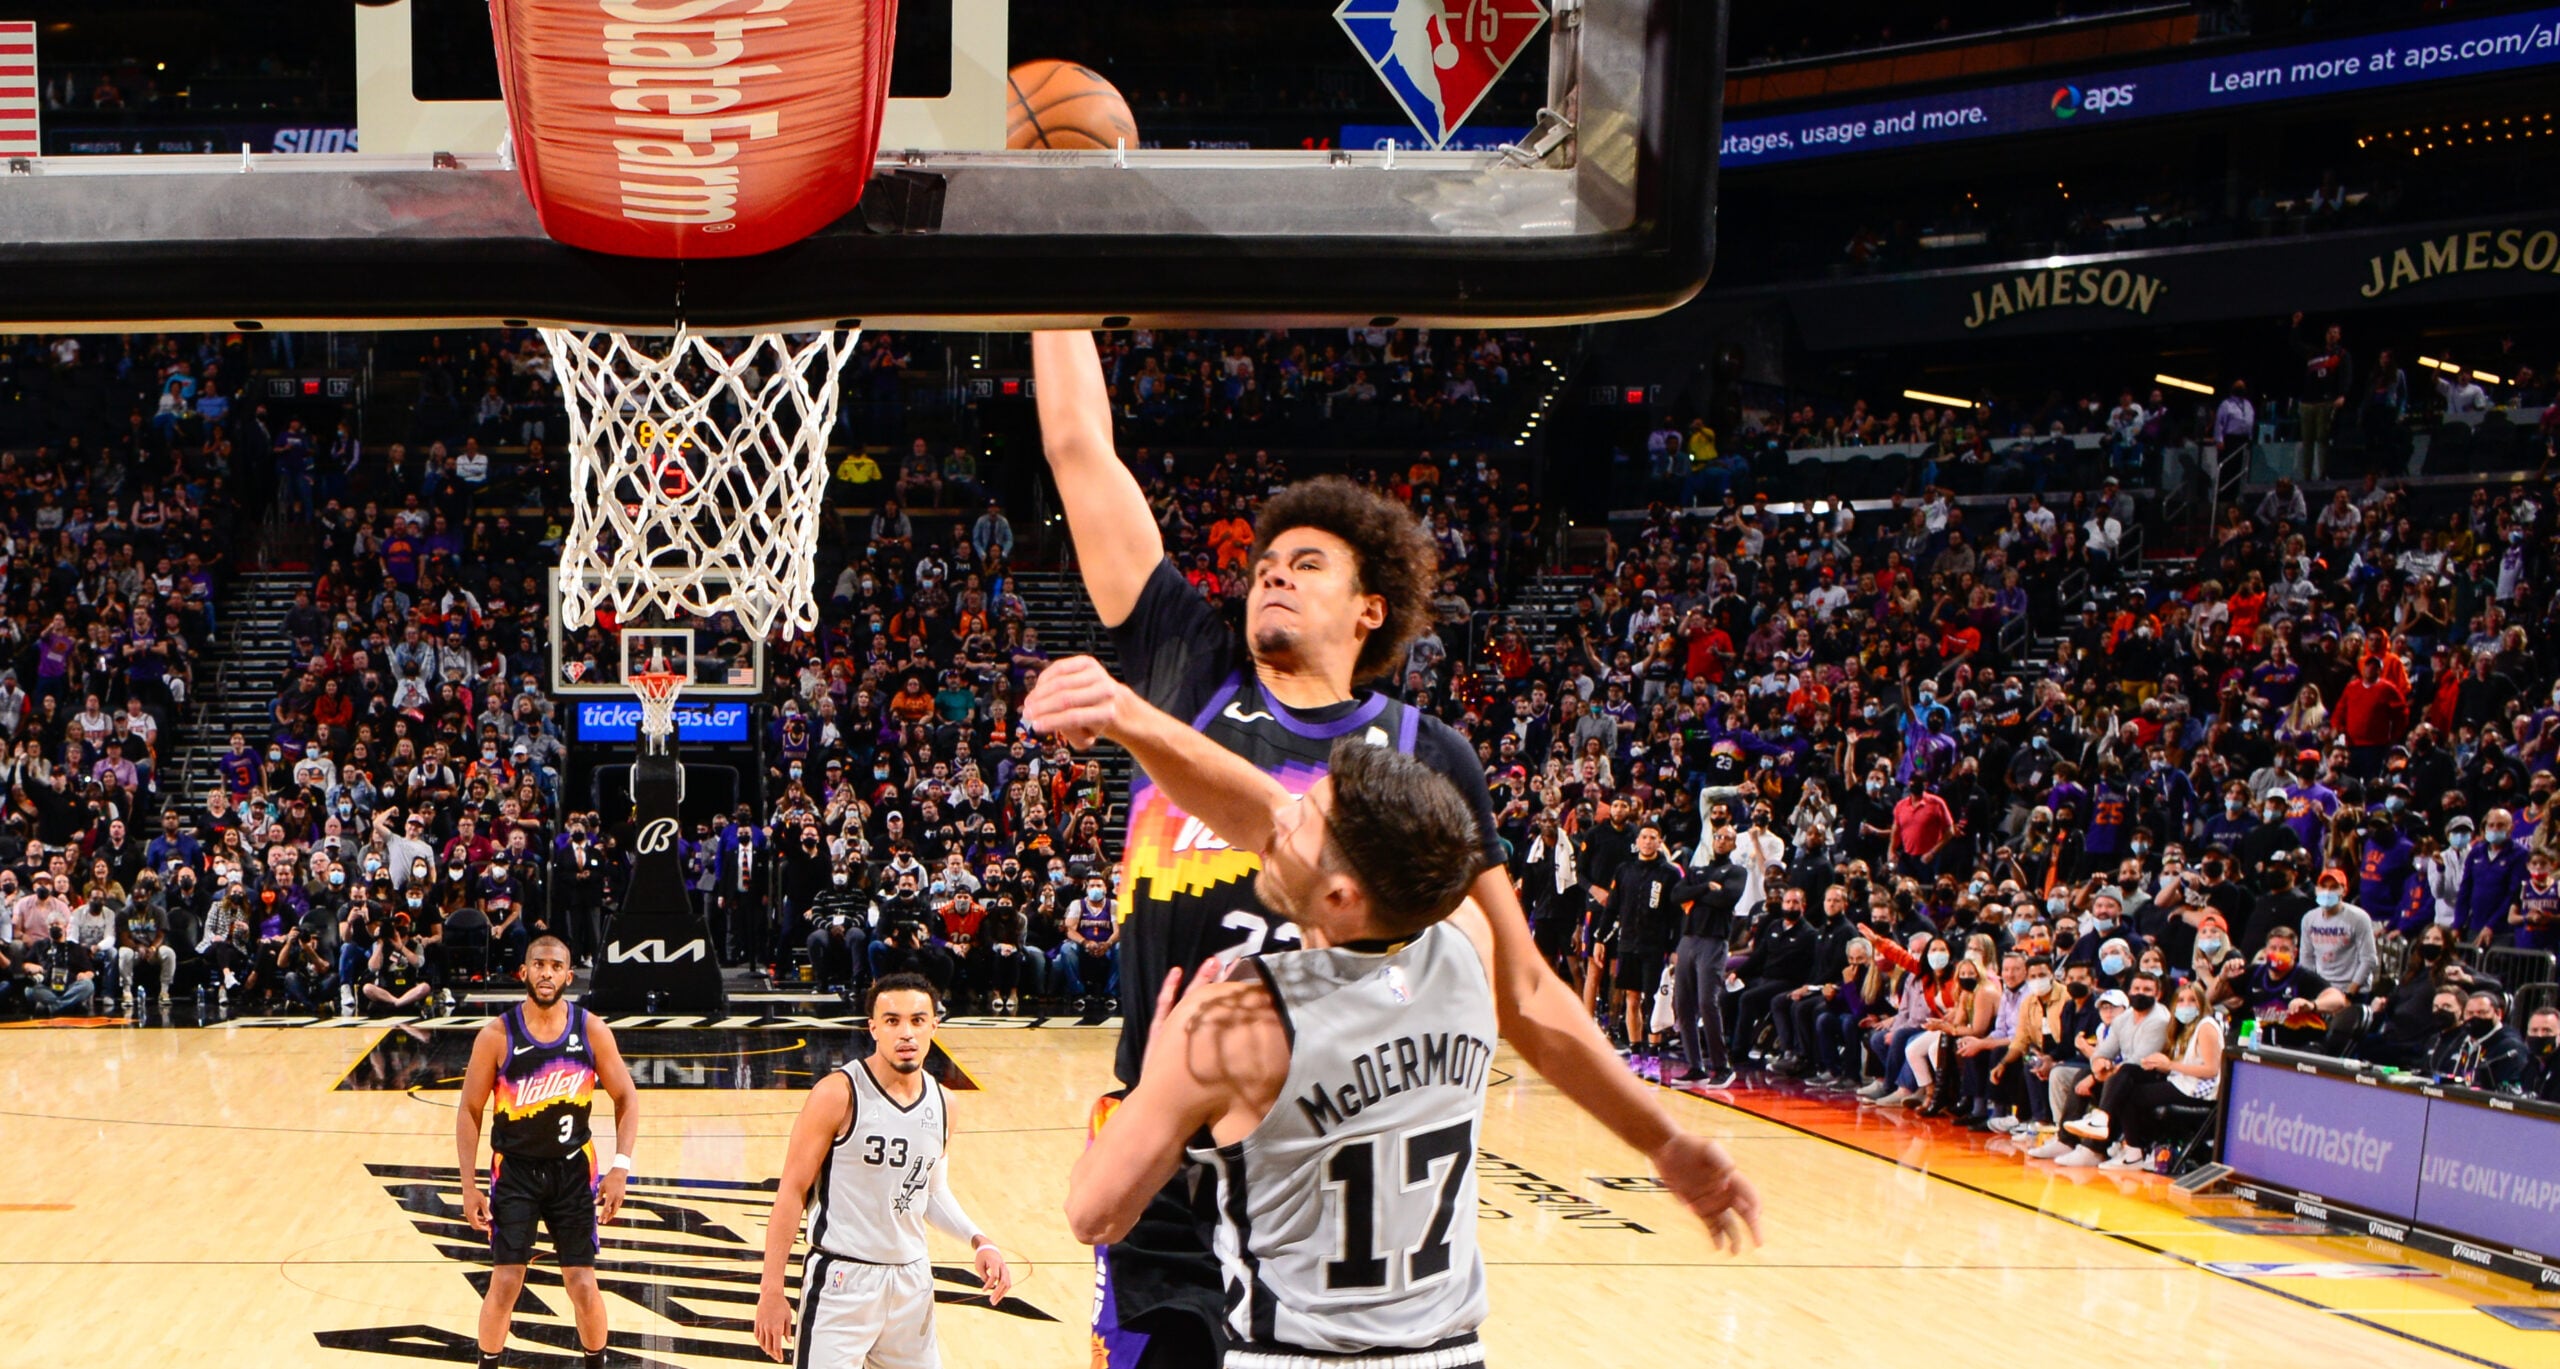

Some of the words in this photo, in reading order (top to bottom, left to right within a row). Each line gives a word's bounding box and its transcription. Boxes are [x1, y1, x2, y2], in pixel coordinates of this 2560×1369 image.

[2209, 66, 2282, 93] Learn
[2291, 55, 2360, 82] more
[2369, 47, 2395, 71] at
[2084, 83, 2134, 113] aps
[1801, 121, 1867, 144] usage
[1873, 111, 1915, 136] and
[1922, 106, 1988, 130] more.
[2361, 228, 2560, 298] JAMESO
[1963, 268, 2162, 329] JAMESON
[583, 704, 742, 727] tickeaster
[236, 766, 250, 786] 3
[1716, 755, 1733, 771] 23
[2095, 802, 2126, 825] 25
[205, 1015, 870, 1029] PHONIX
[515, 1069, 586, 1107] Valley
[1295, 1033, 1491, 1138] McDERMOTT
[558, 1113, 574, 1144] 3
[2237, 1098, 2393, 1174] ticketmaster
[863, 1134, 910, 1169] 33
[1321, 1110, 1477, 1292] 17
[1477, 1147, 1658, 1235] OTPRINT
[2420, 1153, 2461, 1189] LIVE
[2461, 1163, 2512, 1201] ONLY
[2511, 1175, 2560, 1213] HAPP
